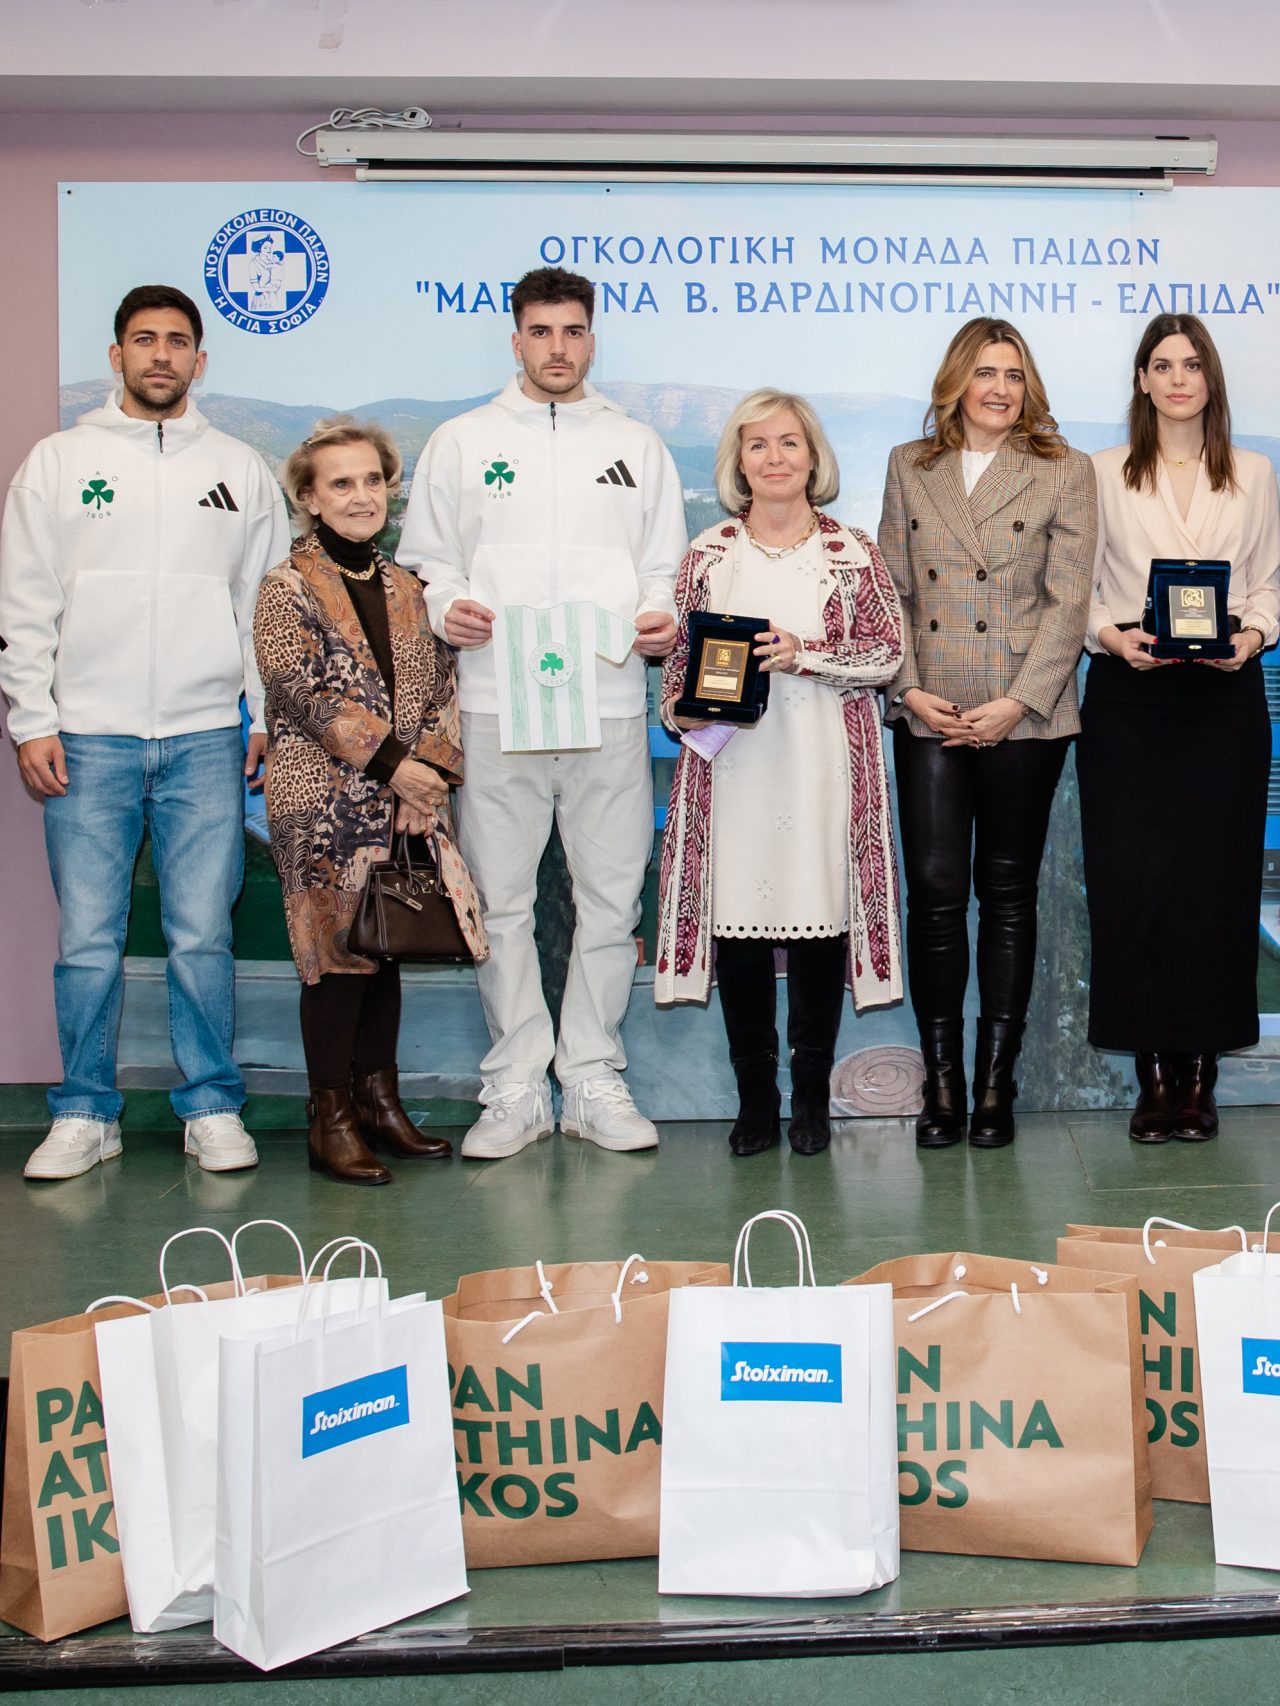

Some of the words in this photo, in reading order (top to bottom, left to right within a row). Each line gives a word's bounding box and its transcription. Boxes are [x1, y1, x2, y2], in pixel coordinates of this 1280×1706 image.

[205, 210, 298, 278] ΝΟΣΟΚΟΜΕΙΟΝ
[298, 223, 329, 283] ΠΑΙΔΩΝ
[539, 235, 795, 265] ΟΓΚΟΛΟΓΙΚΗ
[819, 236, 989, 265] ΜΟΝΑΔΑ
[1012, 237, 1160, 266] ΠΑΙΔΩΝ
[684, 281, 718, 314] Β.
[734, 281, 1077, 314] ΒΑΡΔΙΝΟΓΙΑΝΝΗ
[226, 311, 261, 333] ΑΓΙΑ
[453, 1400, 662, 1466] THINA
